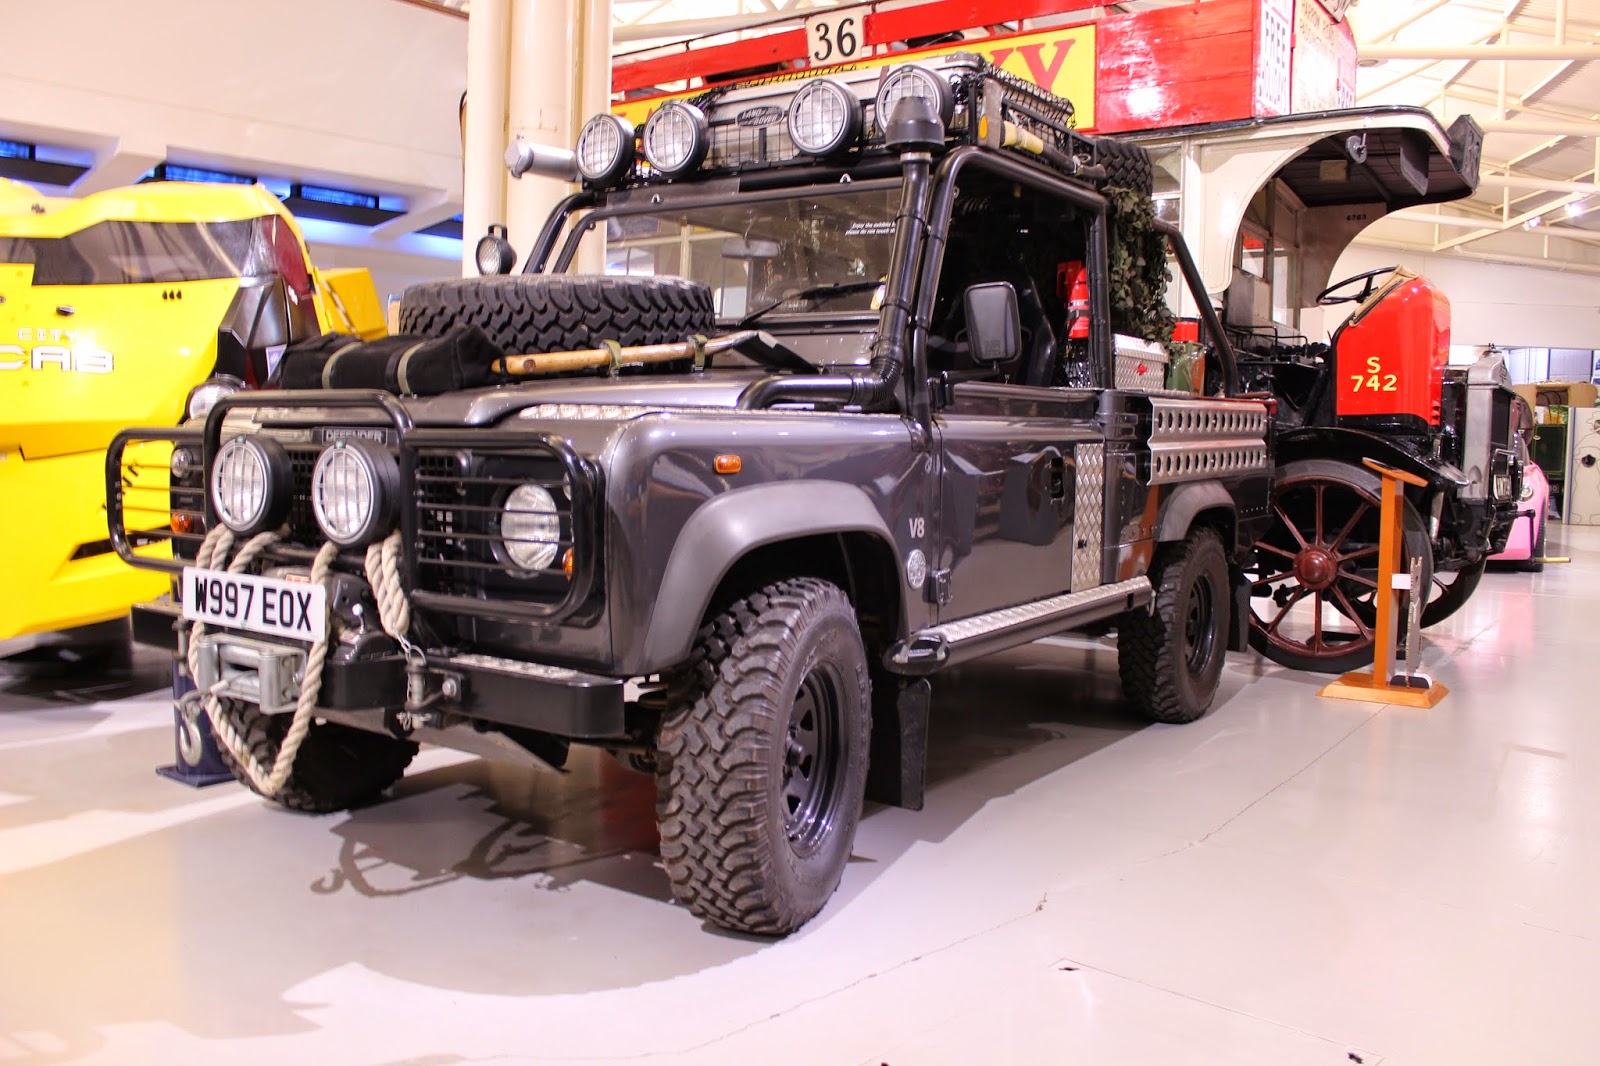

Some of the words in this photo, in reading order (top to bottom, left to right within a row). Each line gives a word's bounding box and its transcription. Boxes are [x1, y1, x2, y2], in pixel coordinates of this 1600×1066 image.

[813, 18, 857, 61] 36
[742, 109, 762, 119] LAND
[753, 114, 778, 125] ROVER
[17, 327, 78, 342] CITY
[0, 344, 115, 375] CAB
[1366, 356, 1381, 374] S
[1351, 374, 1398, 392] 742
[908, 516, 925, 539] V8
[195, 576, 254, 621] W997
[262, 586, 312, 632] EOX
